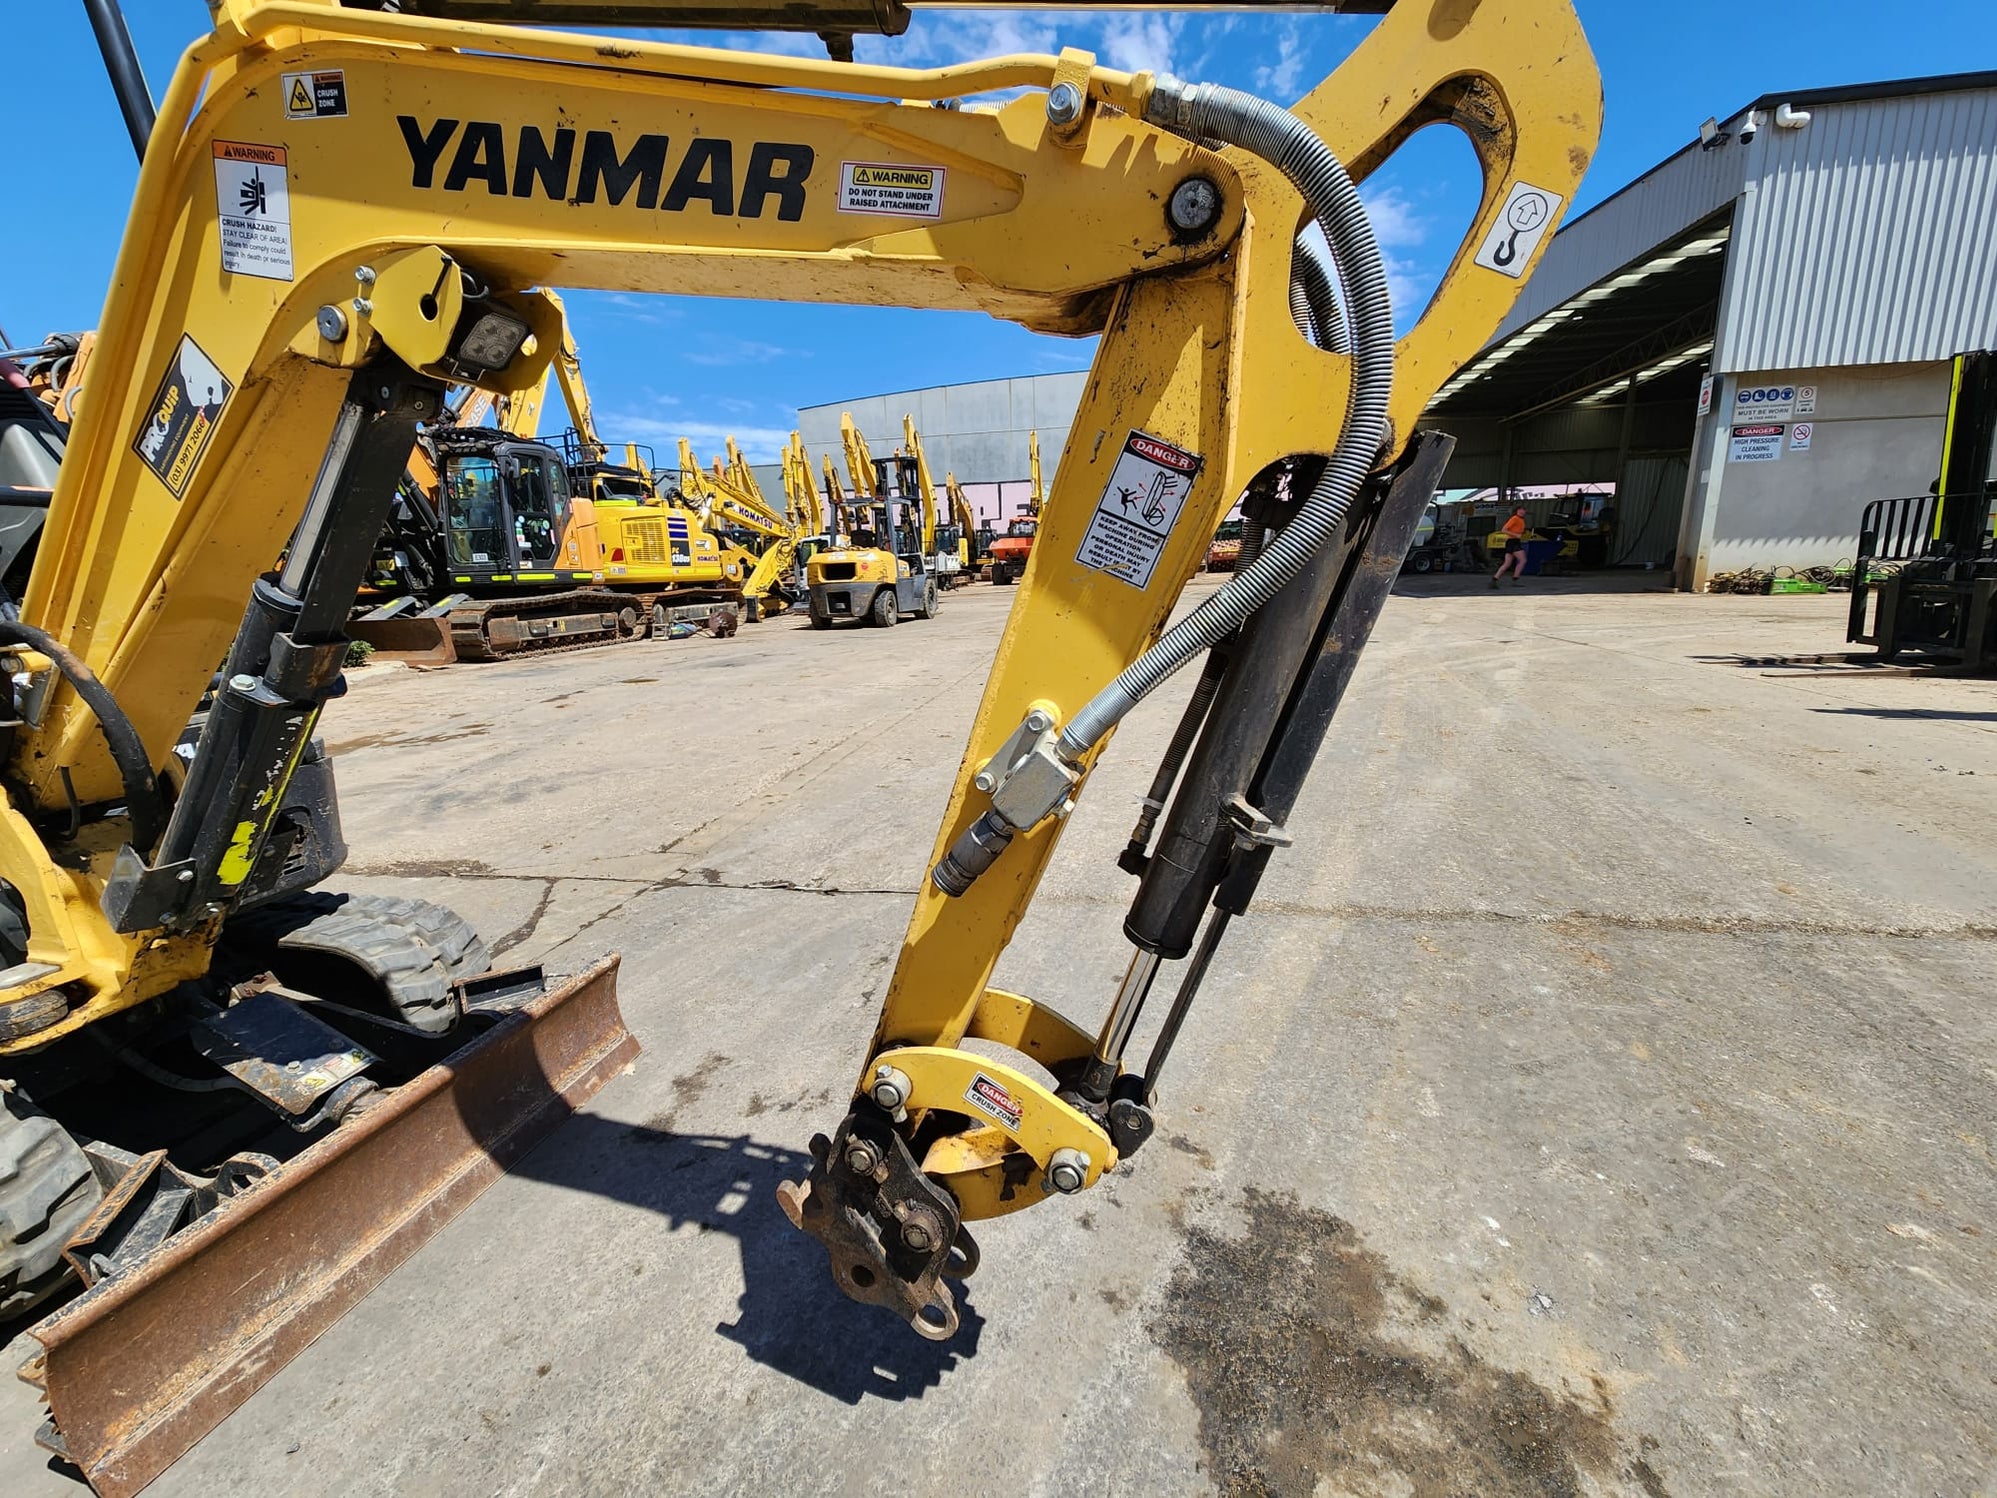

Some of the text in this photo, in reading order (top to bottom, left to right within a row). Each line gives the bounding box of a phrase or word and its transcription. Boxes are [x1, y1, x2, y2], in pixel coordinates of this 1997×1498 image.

[317, 88, 338, 98] CRUSH
[319, 100, 336, 108] ZONE
[232, 147, 275, 161] WARNING
[397, 115, 814, 222] YANMAR
[872, 171, 928, 184] WARNING
[848, 188, 933, 201] DO NOT STAND UNDER
[850, 198, 930, 212] RAISED ATTACHMENT
[222, 218, 278, 232] CRUSH HAZARD!
[223, 229, 238, 238] STAY
[239, 232, 258, 240] CLEAR
[260, 234, 268, 242] OF
[250, 244, 270, 254] comply
[1136, 441, 1190, 468] DANGER
[170, 464, 183, 485] (03)
[180, 444, 194, 466] 9971
[738, 506, 772, 529] KOMATSU
[1098, 522, 1155, 550] MACHINE DURING
[1100, 516, 1158, 544] KEEP AWAY FROM
[1090, 534, 1150, 564] PERSONAL INJURY
[1104, 534, 1142, 552] OPERATION
[1088, 549, 1112, 562] RESULT
[1090, 558, 1102, 566] THE
[1094, 544, 1104, 552] OR
[1105, 548, 1126, 561] DEATH
[1126, 558, 1142, 567] MAY
[982, 1085, 1019, 1113] DANGER
[972, 1094, 1017, 1126] CRUSH ZONE
